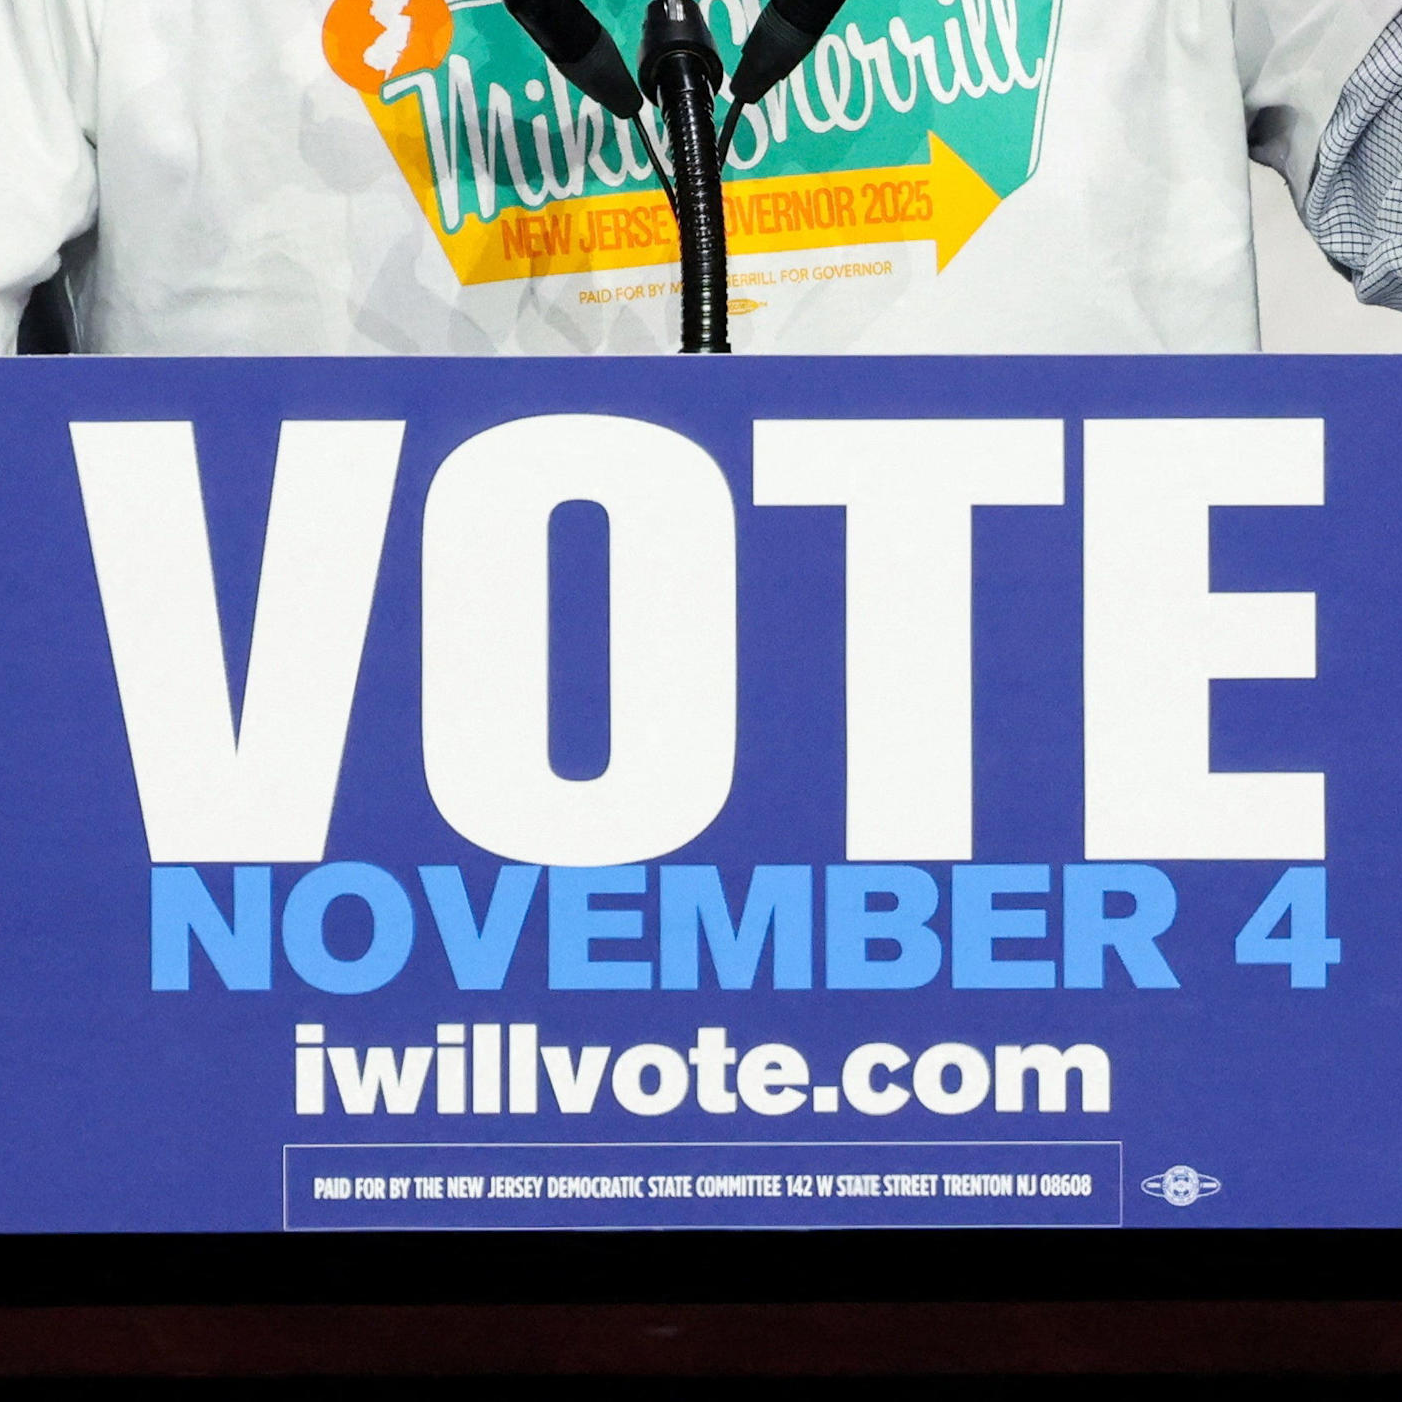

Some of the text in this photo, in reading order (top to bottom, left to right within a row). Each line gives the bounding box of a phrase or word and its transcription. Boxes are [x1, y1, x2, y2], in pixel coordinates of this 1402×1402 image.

[500, 179, 935, 261] NEW JERSE OVERNOR 2025
[579, 289, 611, 304] PAID
[616, 286, 643, 302] FOR
[648, 284, 665, 298] BY
[727, 271, 777, 288] ERRILL
[781, 268, 809, 284] FOR
[813, 260, 893, 280] GOVERNOR
[69, 414, 1326, 867] VOTE
[151, 862, 1341, 995] NOVEMBER 4
[295, 1023, 1111, 1116] iwillvote.com
[313, 1173, 1092, 1200] PAID FOR BY THE NEW JERSEY DEMOCRATIC STATE COMMITTEE 142 W STATE STREET TRENTON NJ 08608
